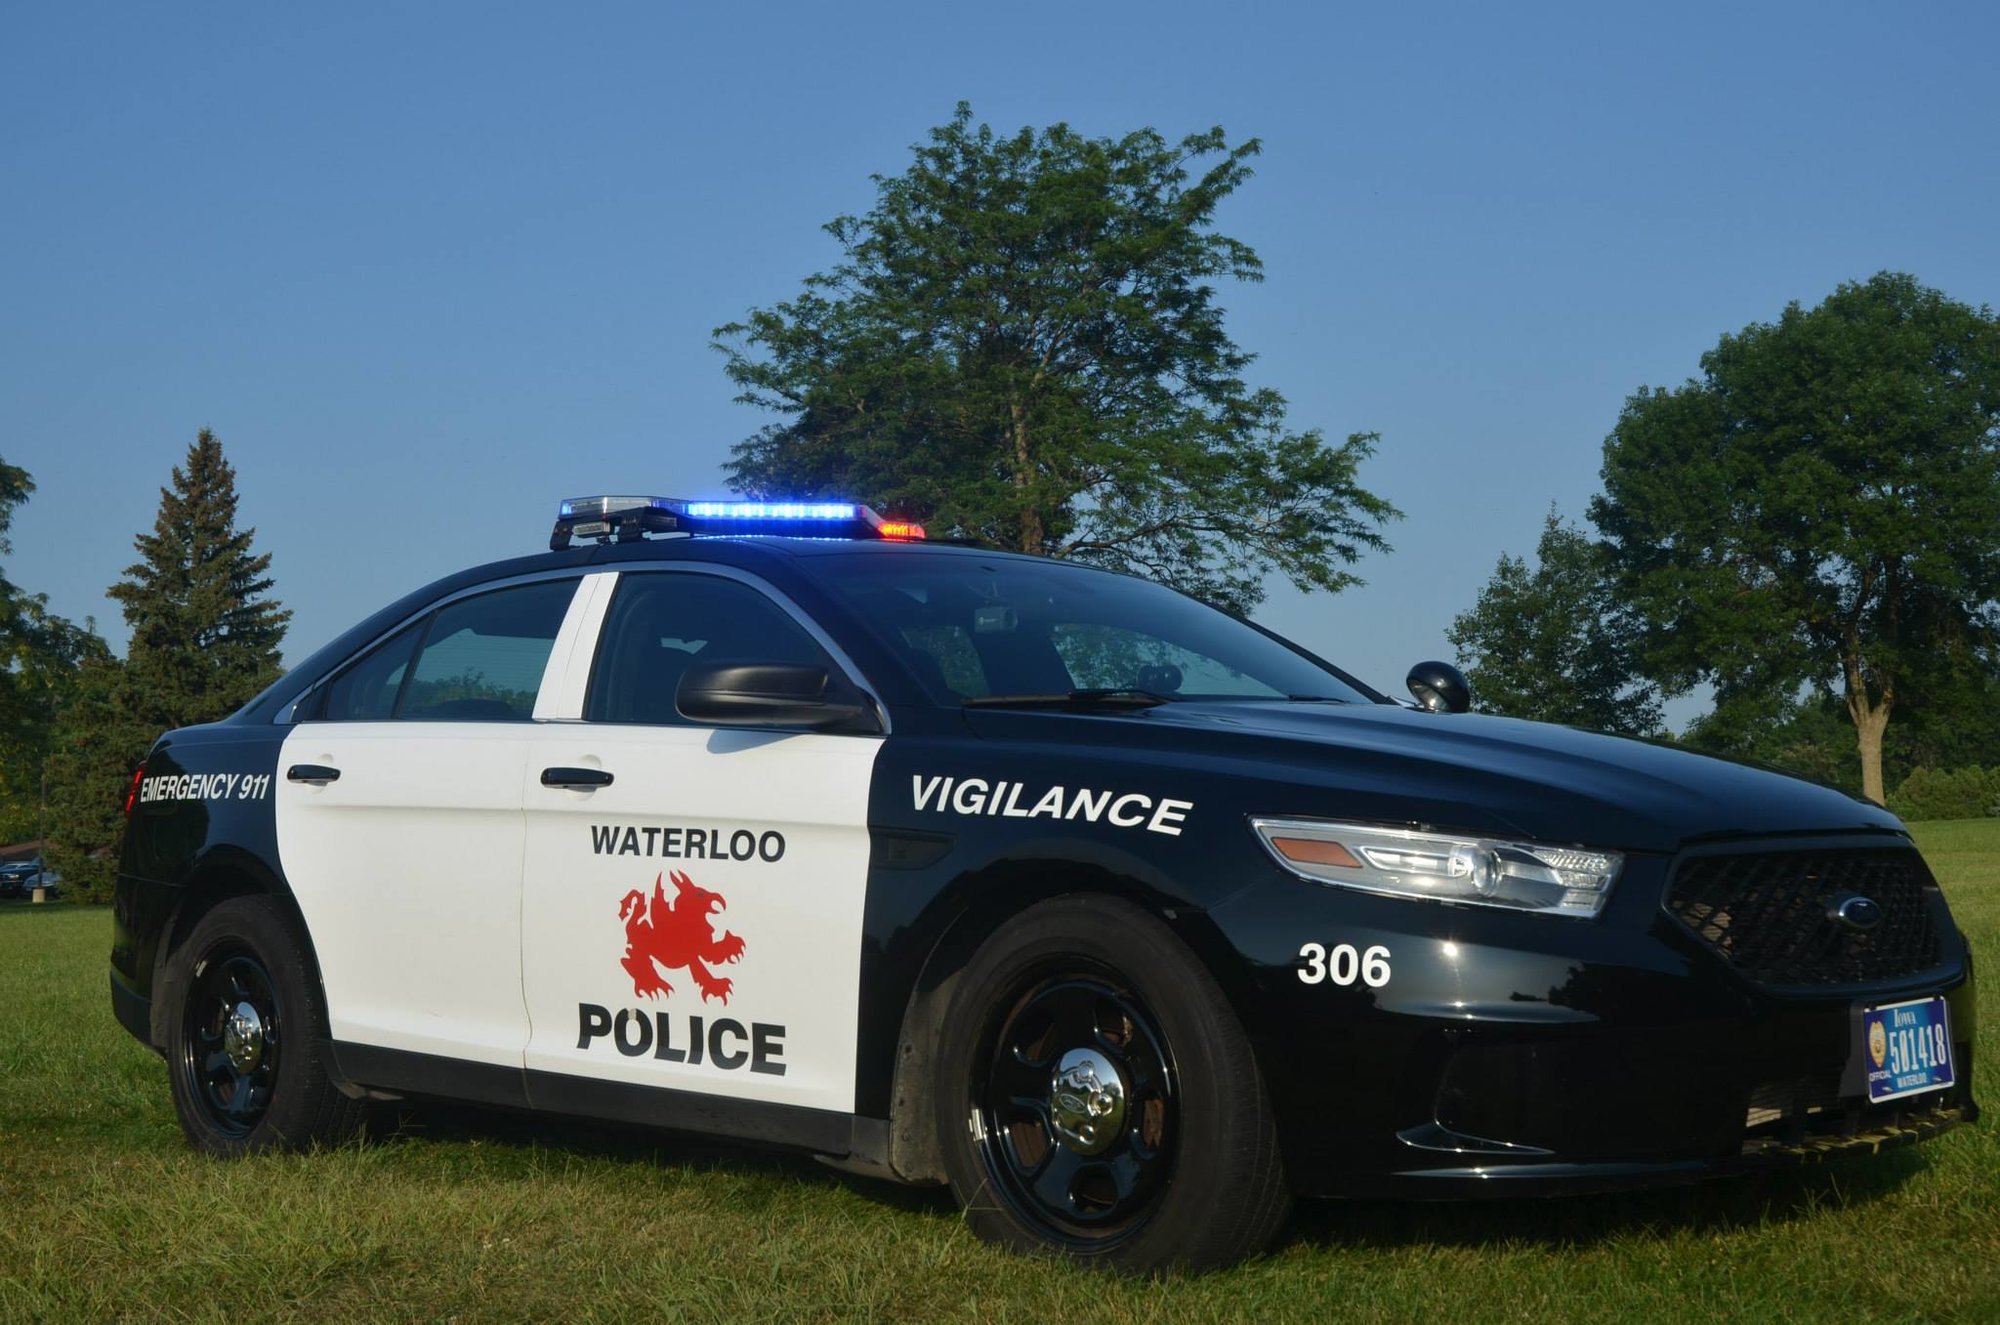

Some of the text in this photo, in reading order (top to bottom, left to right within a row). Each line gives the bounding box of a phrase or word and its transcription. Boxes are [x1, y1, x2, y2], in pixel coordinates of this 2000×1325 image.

[140, 774, 271, 803] EMERGENCY 911
[911, 774, 1193, 836] VIGILANCE
[591, 826, 786, 863] WATERLOO
[1297, 942, 1392, 988] 306
[576, 1002, 787, 1077] POLICE
[1889, 1024, 1947, 1074] 501418
[1869, 1070, 1892, 1082] OFFICIAL
[1897, 1072, 1928, 1088] WATERLOO
